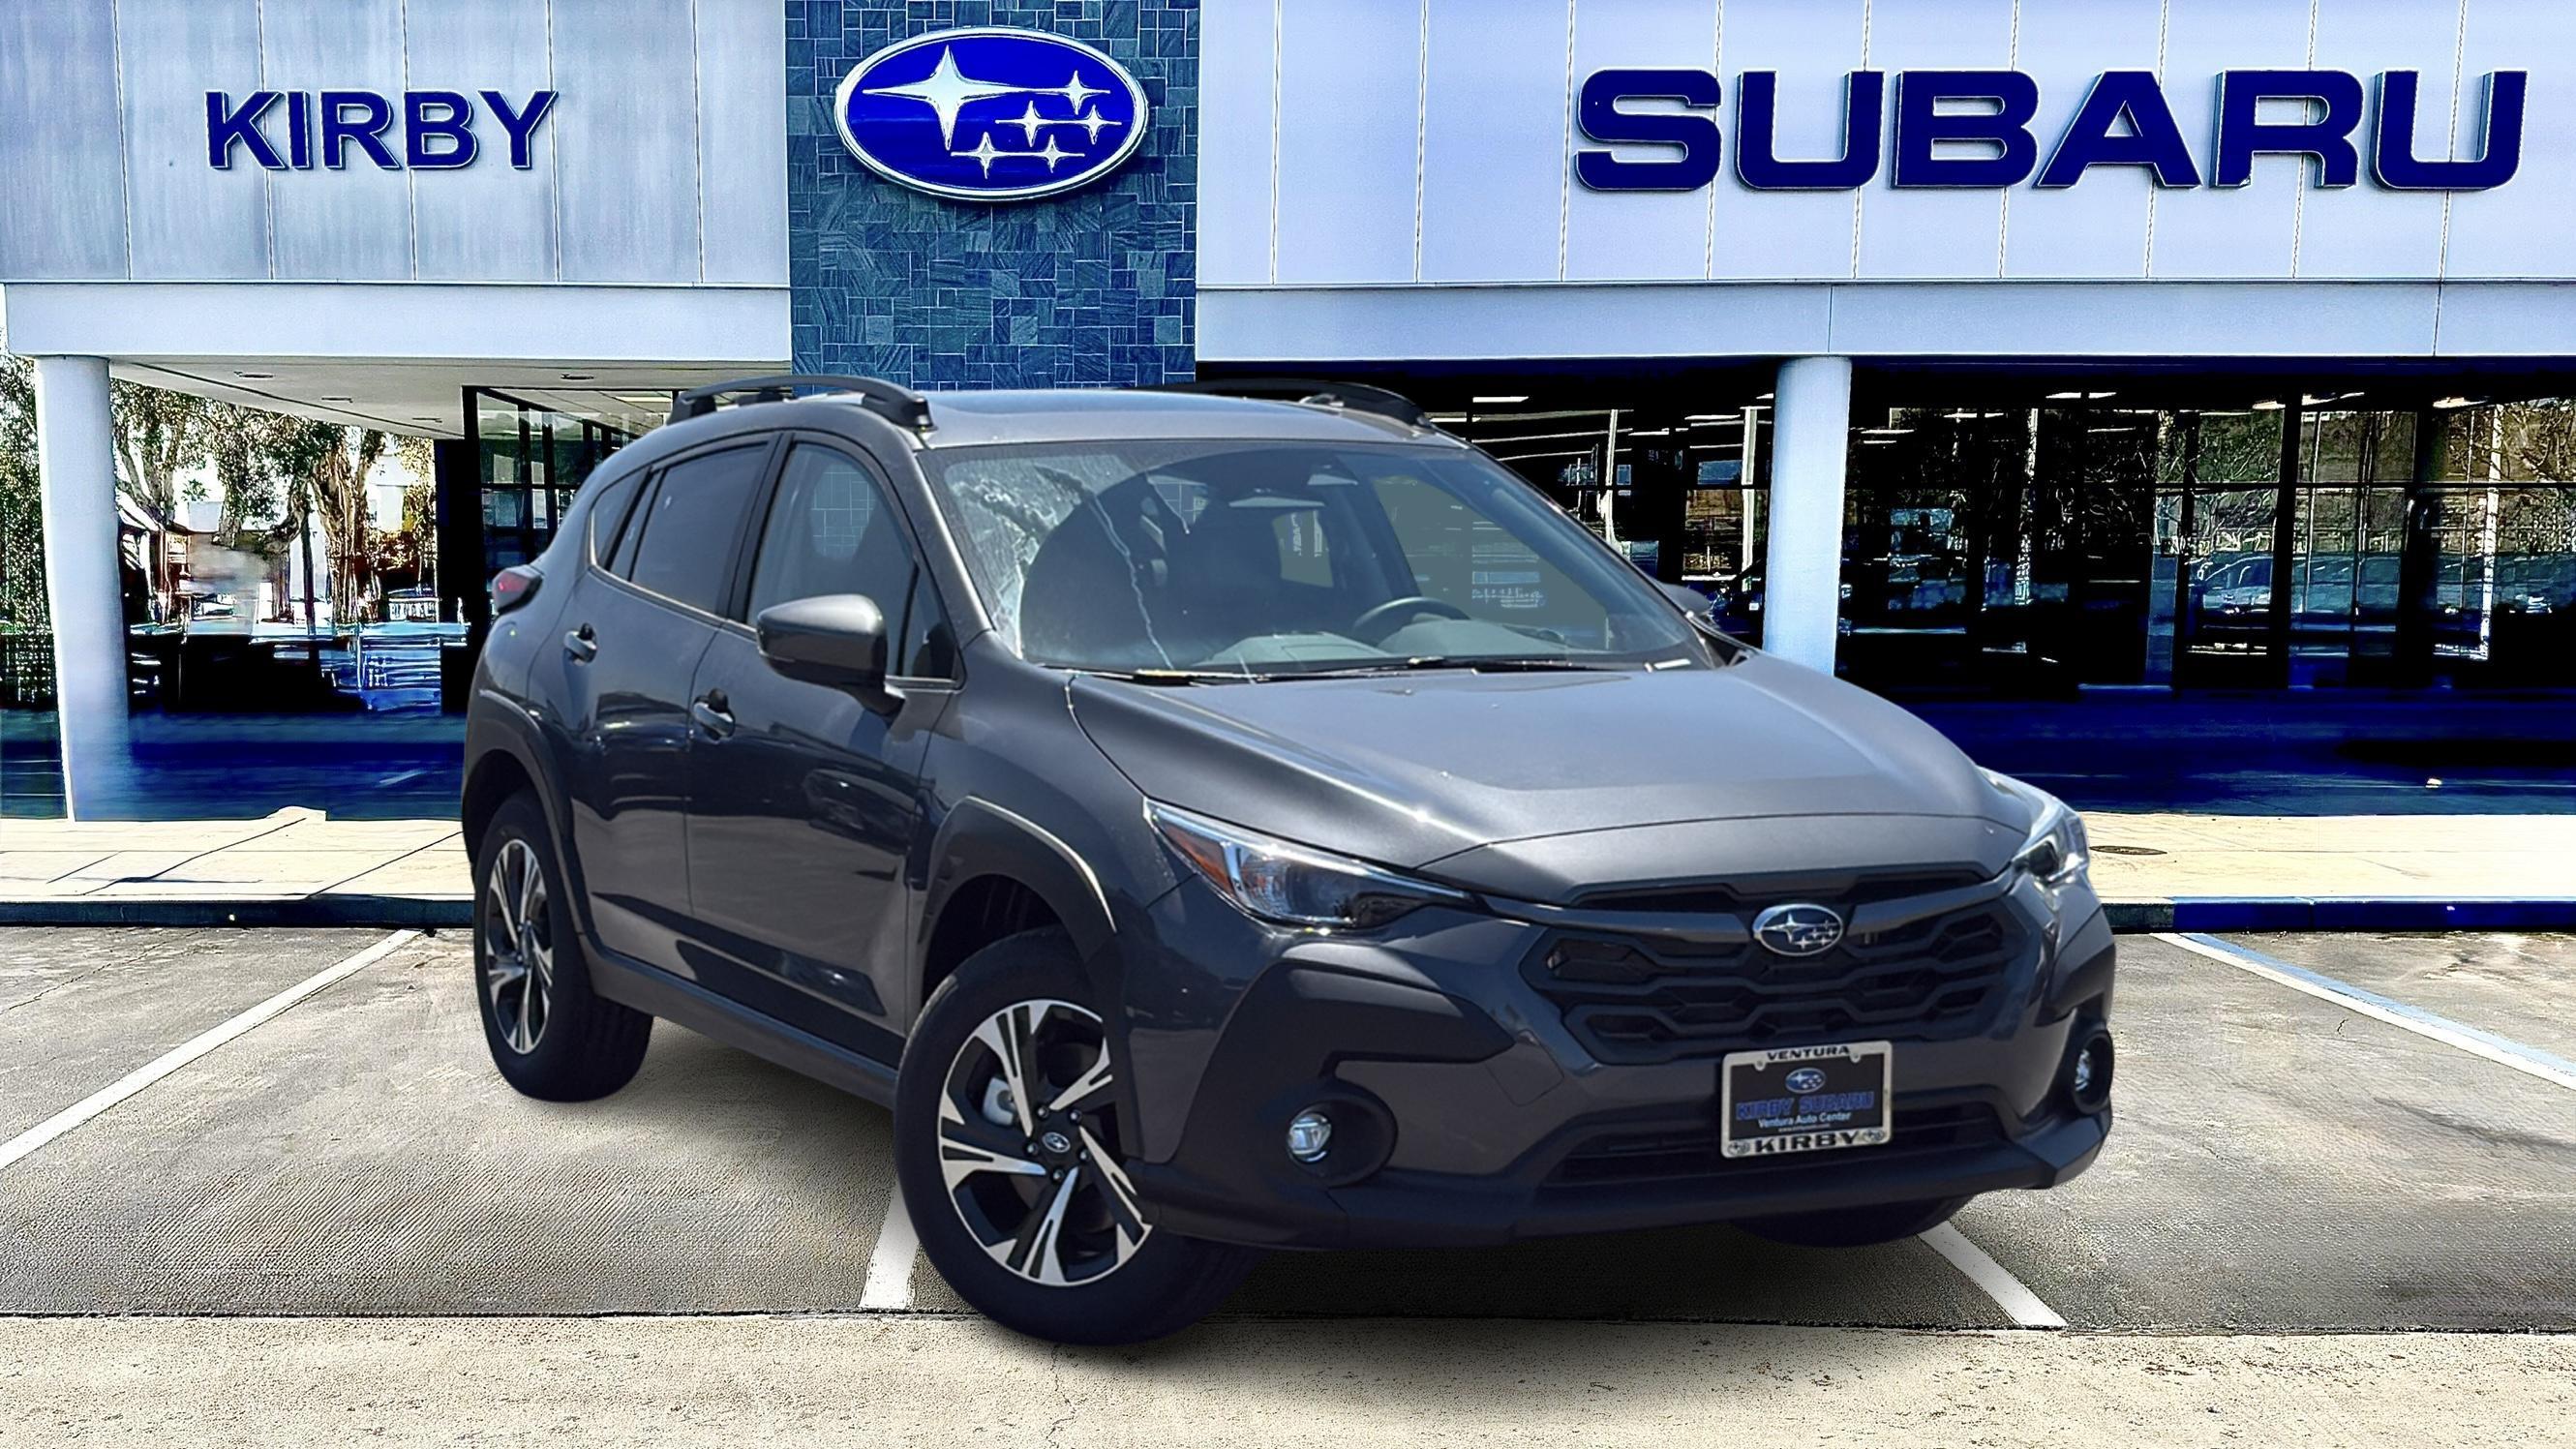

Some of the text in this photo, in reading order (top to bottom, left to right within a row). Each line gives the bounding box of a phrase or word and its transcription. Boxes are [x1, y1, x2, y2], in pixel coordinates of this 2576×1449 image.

[206, 91, 560, 170] KIRBY
[1576, 69, 2528, 191] SUBARU
[1768, 1046, 1849, 1061] VENTURA
[1737, 1092, 1874, 1119] KIRBY SUBARU
[1758, 1117, 1794, 1128] Ventura
[1796, 1114, 1818, 1125] Auto
[1819, 1111, 1852, 1123] Center
[1756, 1132, 1860, 1153] KIRBY
